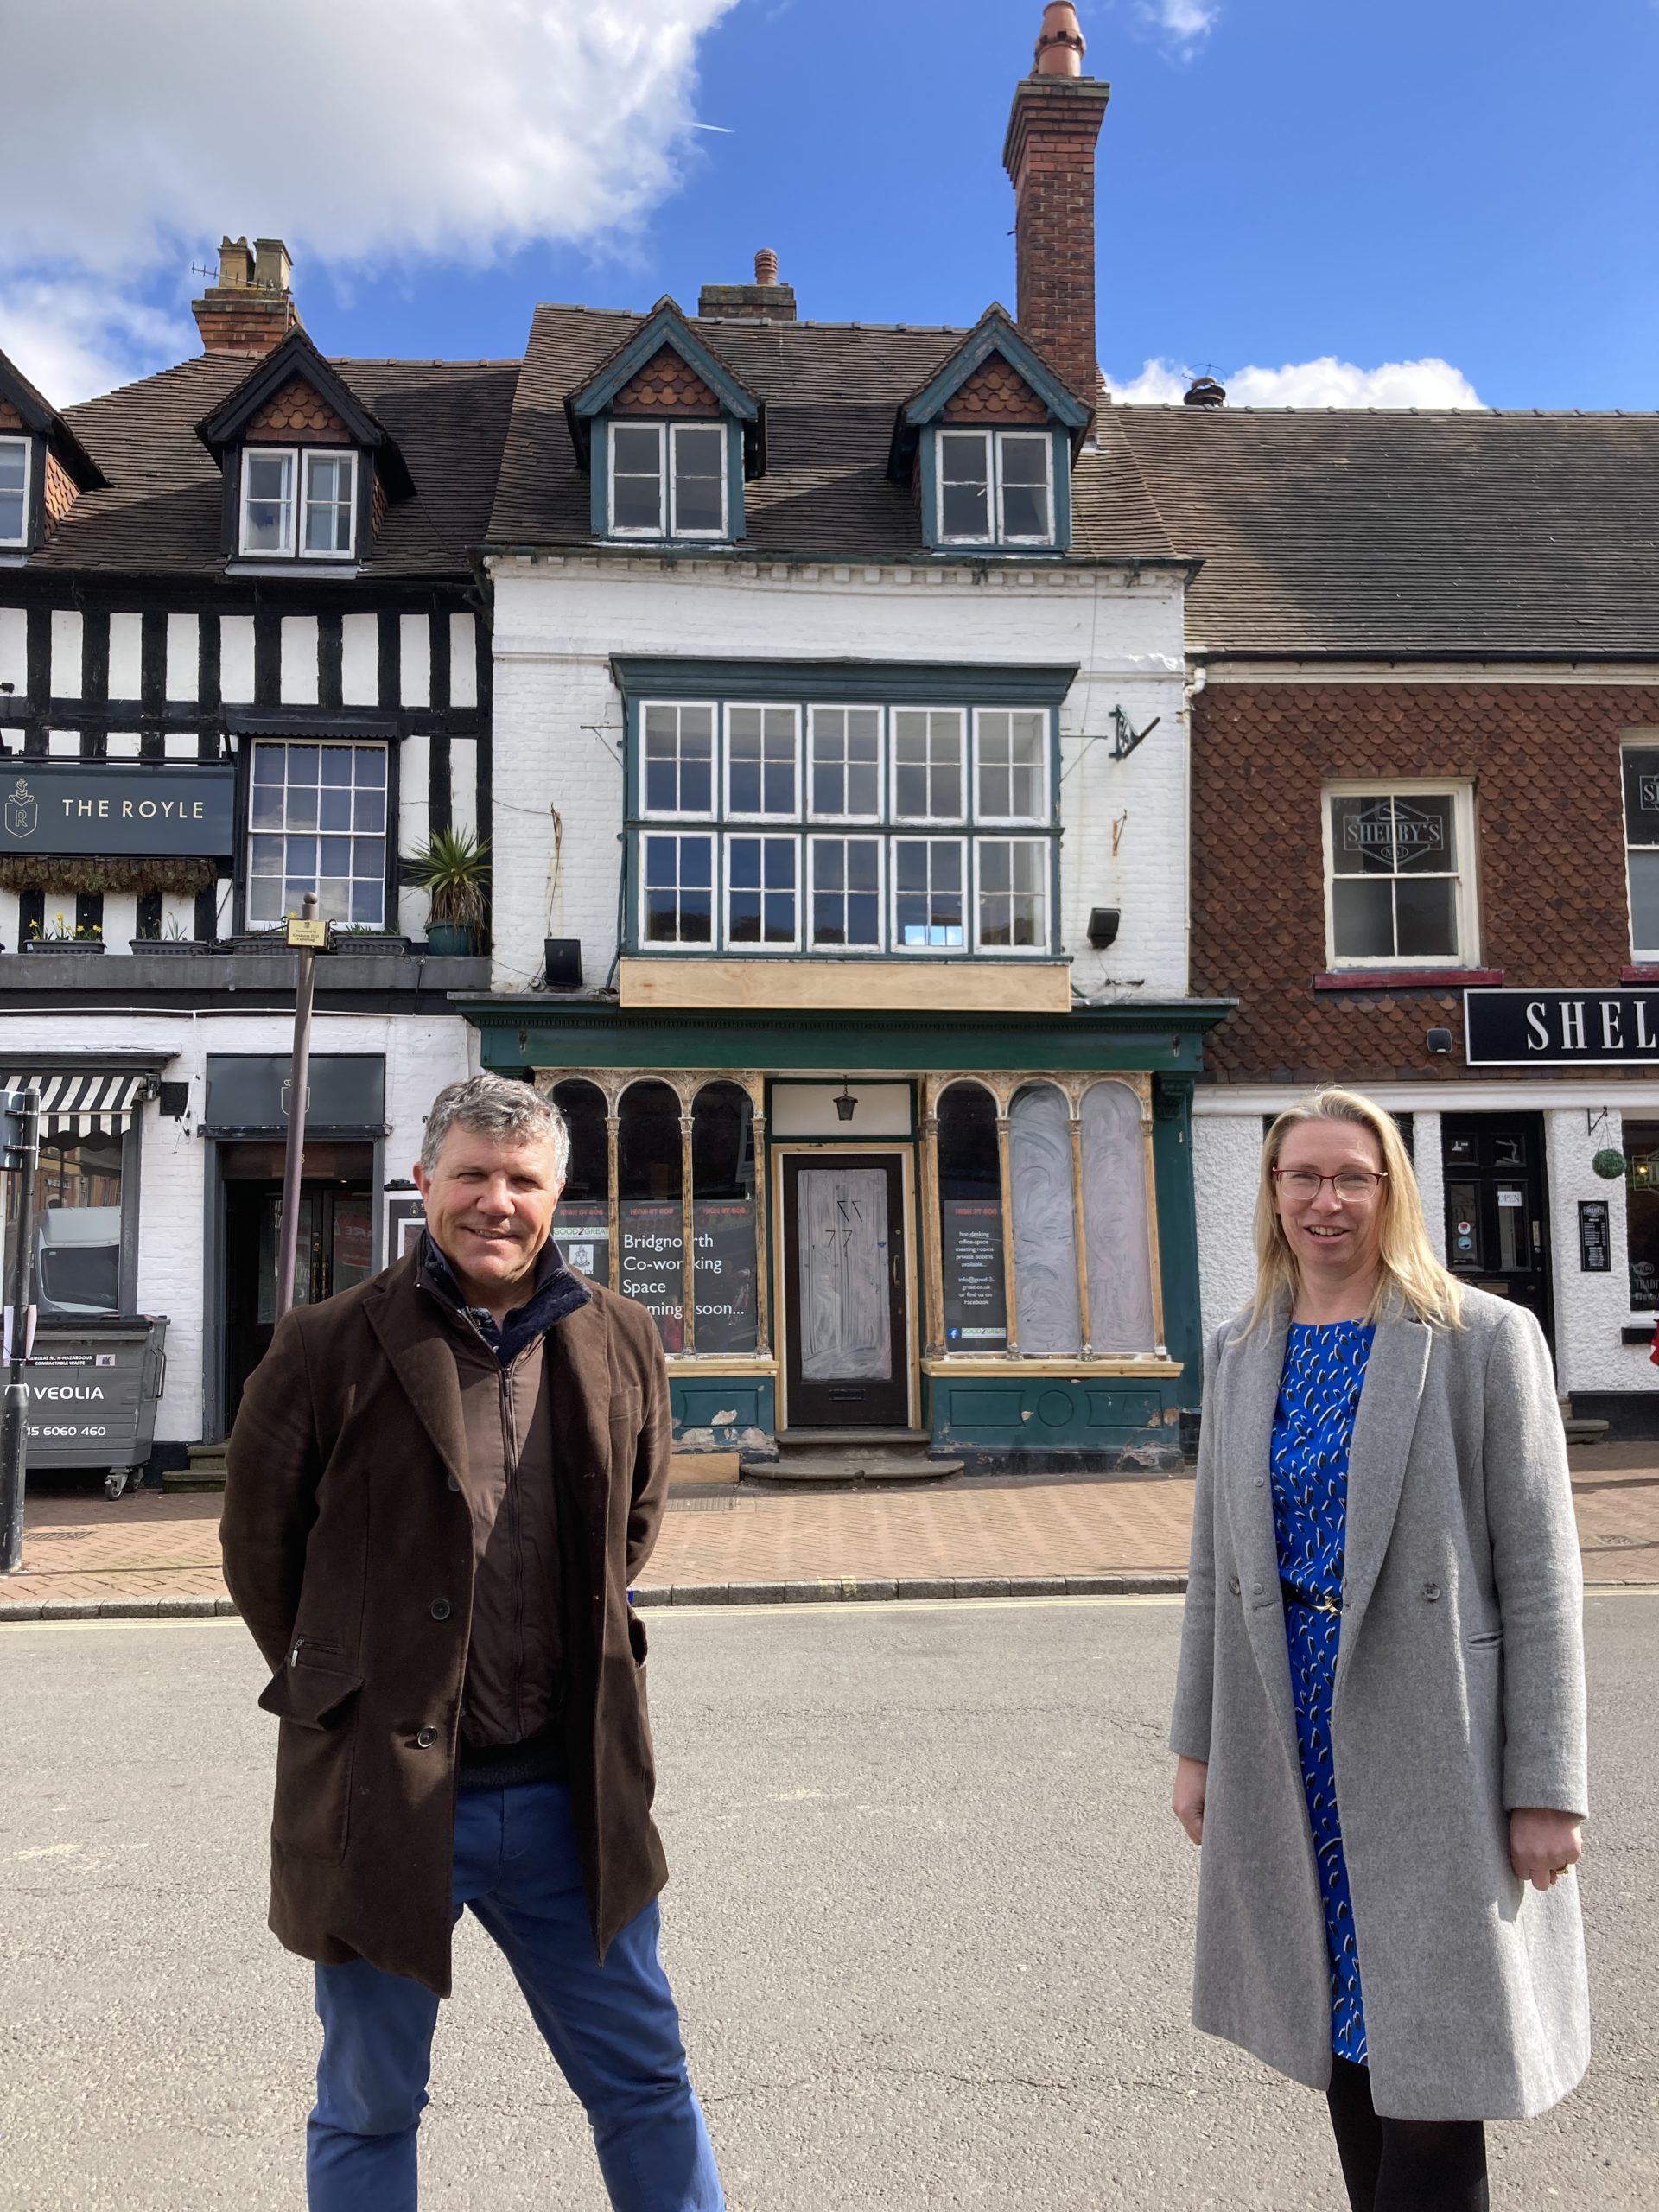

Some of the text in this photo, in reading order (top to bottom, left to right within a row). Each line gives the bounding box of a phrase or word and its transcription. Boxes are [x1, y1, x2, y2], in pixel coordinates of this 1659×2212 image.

[62, 799, 204, 819] THE ROYLE
[15, 809, 29, 828] R
[1498, 1193, 1521, 1203] OPEN
[623, 1233, 714, 1252] Bridgnorth
[623, 1255, 722, 1274] Co-working
[623, 1279, 666, 1297] Space
[646, 1302, 745, 1319] ming soon...
[34, 1386, 105, 1400] VEOLIA
[43, 1427, 77, 1436] 6060
[80, 1427, 106, 1436] 460
